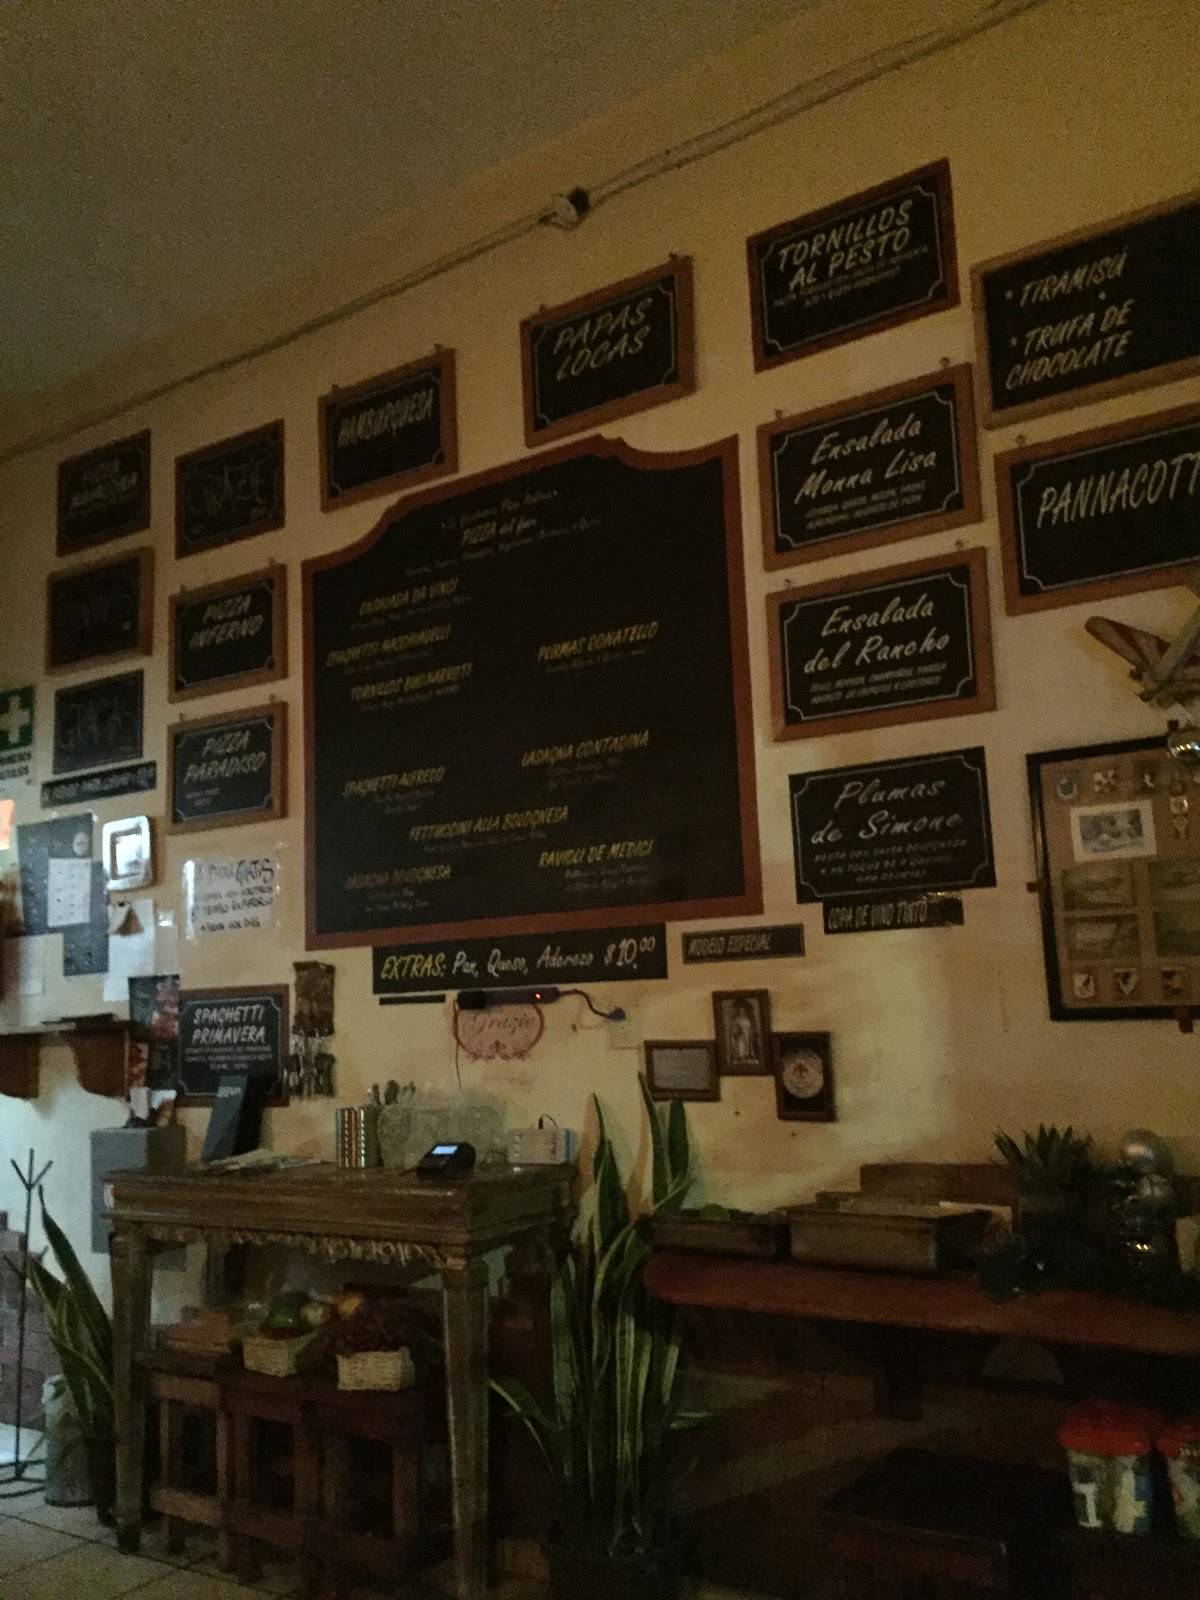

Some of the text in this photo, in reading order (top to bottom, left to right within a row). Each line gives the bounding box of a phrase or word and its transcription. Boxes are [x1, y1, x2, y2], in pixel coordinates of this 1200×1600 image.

[778, 199, 912, 271] TORNILLOS
[789, 262, 817, 290] AL
[828, 226, 910, 278] PESTO
[553, 297, 653, 355] PAPAS
[1024, 298, 1136, 356] TRUFA DE
[556, 325, 649, 381] LOCAS
[1005, 330, 1134, 390] CHOCOLATE
[811, 412, 921, 465] Ensalada
[794, 449, 936, 505] Monna Lisa
[202, 594, 251, 624] PIZZA
[821, 593, 933, 638] Ensalada
[187, 614, 263, 651] INFERNO
[588, 620, 659, 651] DONATELLO
[804, 626, 950, 674] del Rancho
[201, 730, 250, 757] PIZZA
[521, 729, 650, 768] LASAGNA CONTADINA
[184, 751, 266, 784] PARADISO
[399, 766, 446, 787] ALFREDO
[834, 779, 946, 810] Plumas
[501, 806, 569, 832] BOLOGNESA
[811, 810, 963, 844] de Simone
[538, 838, 657, 869] RAVIOLI DE MEDICI
[855, 904, 869, 928] DE
[870, 901, 894, 927] VINO
[688, 933, 772, 956] MODELO ESPECIAL
[380, 951, 447, 980] EXTRAS:
[487, 948, 528, 978] Queso,
[537, 945, 595, 970] Aderezo
[193, 1003, 265, 1025] SPAGHETTI
[192, 1024, 266, 1046] PRIMAVERA
